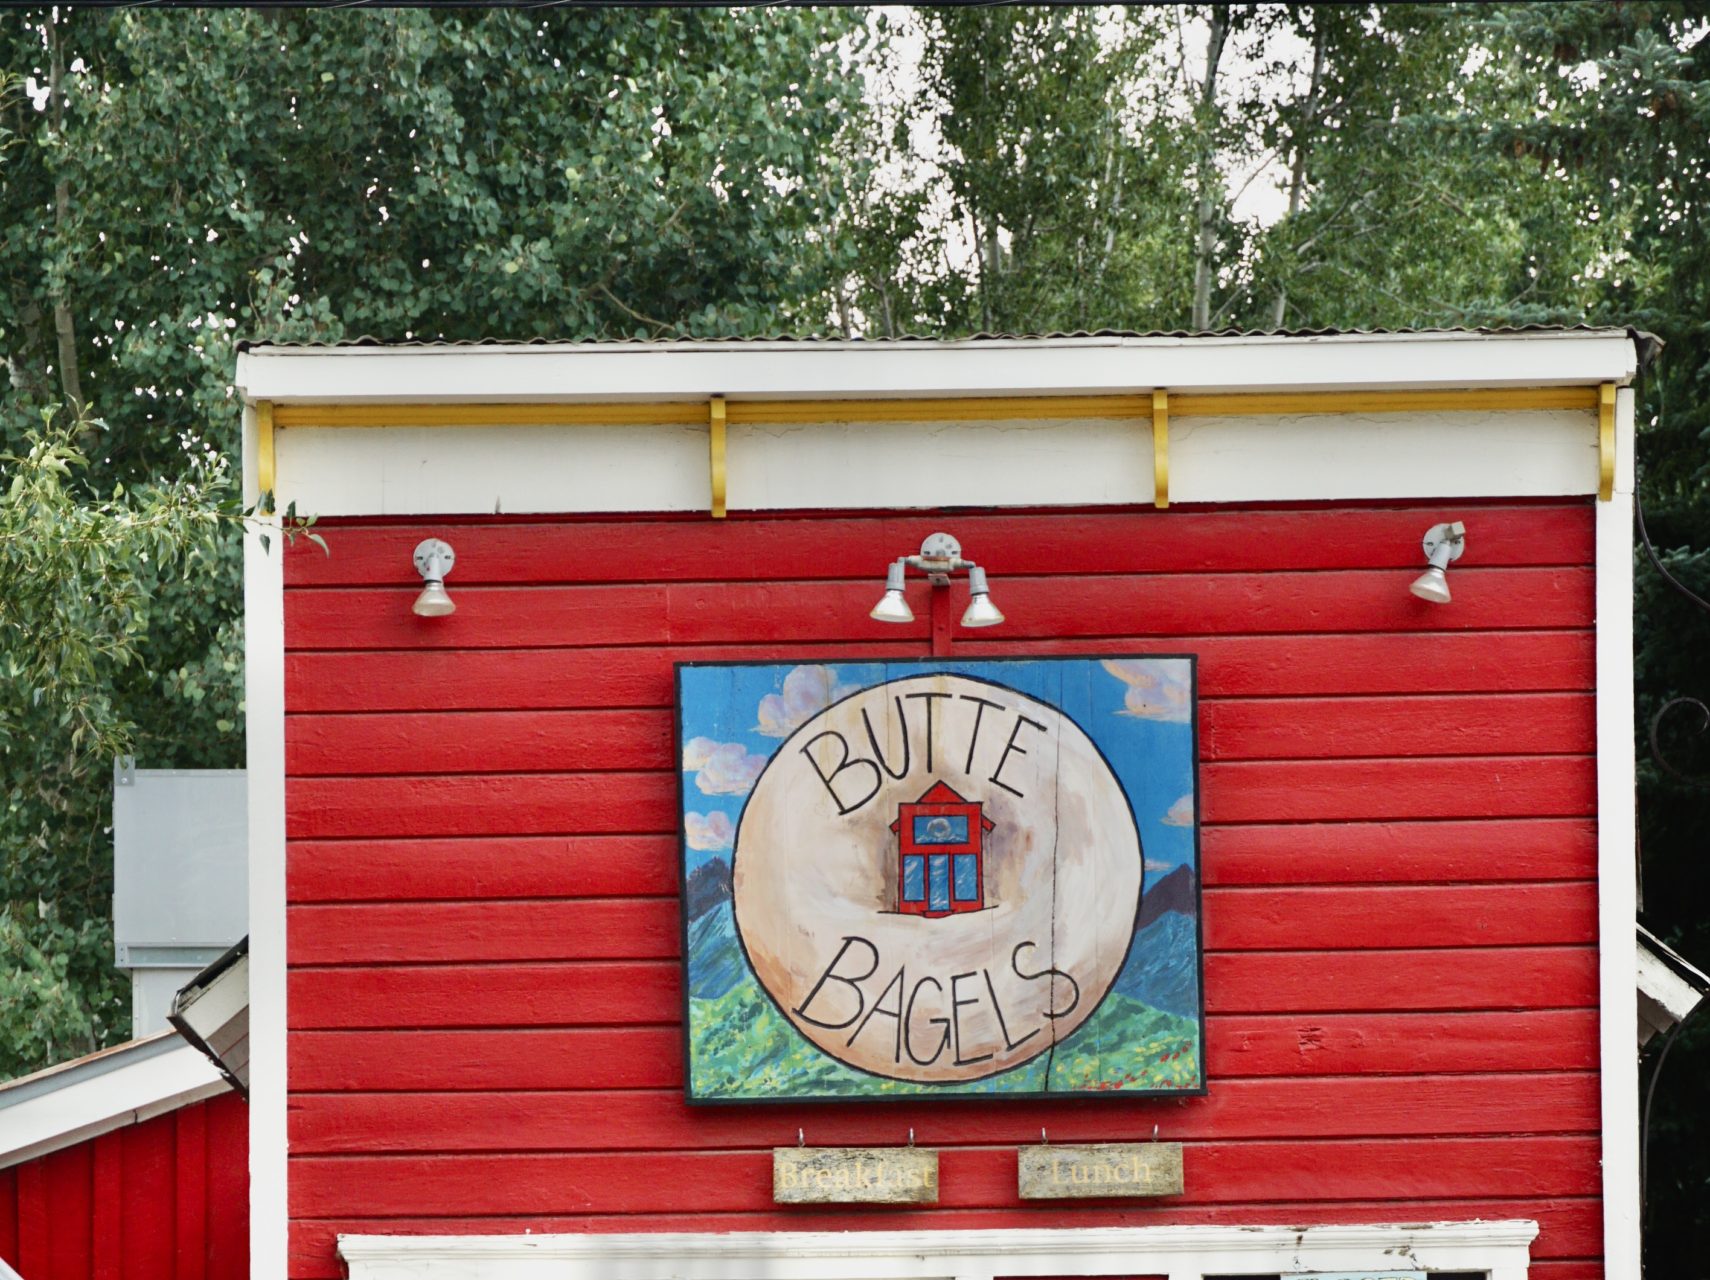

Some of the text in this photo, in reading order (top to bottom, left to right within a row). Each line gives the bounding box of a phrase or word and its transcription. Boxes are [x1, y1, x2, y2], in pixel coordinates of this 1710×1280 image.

[799, 692, 1048, 816] BUTTE
[792, 936, 1080, 1067] BAGELS
[781, 1162, 934, 1189] Breakfast
[1053, 1157, 1152, 1185] Lunch
